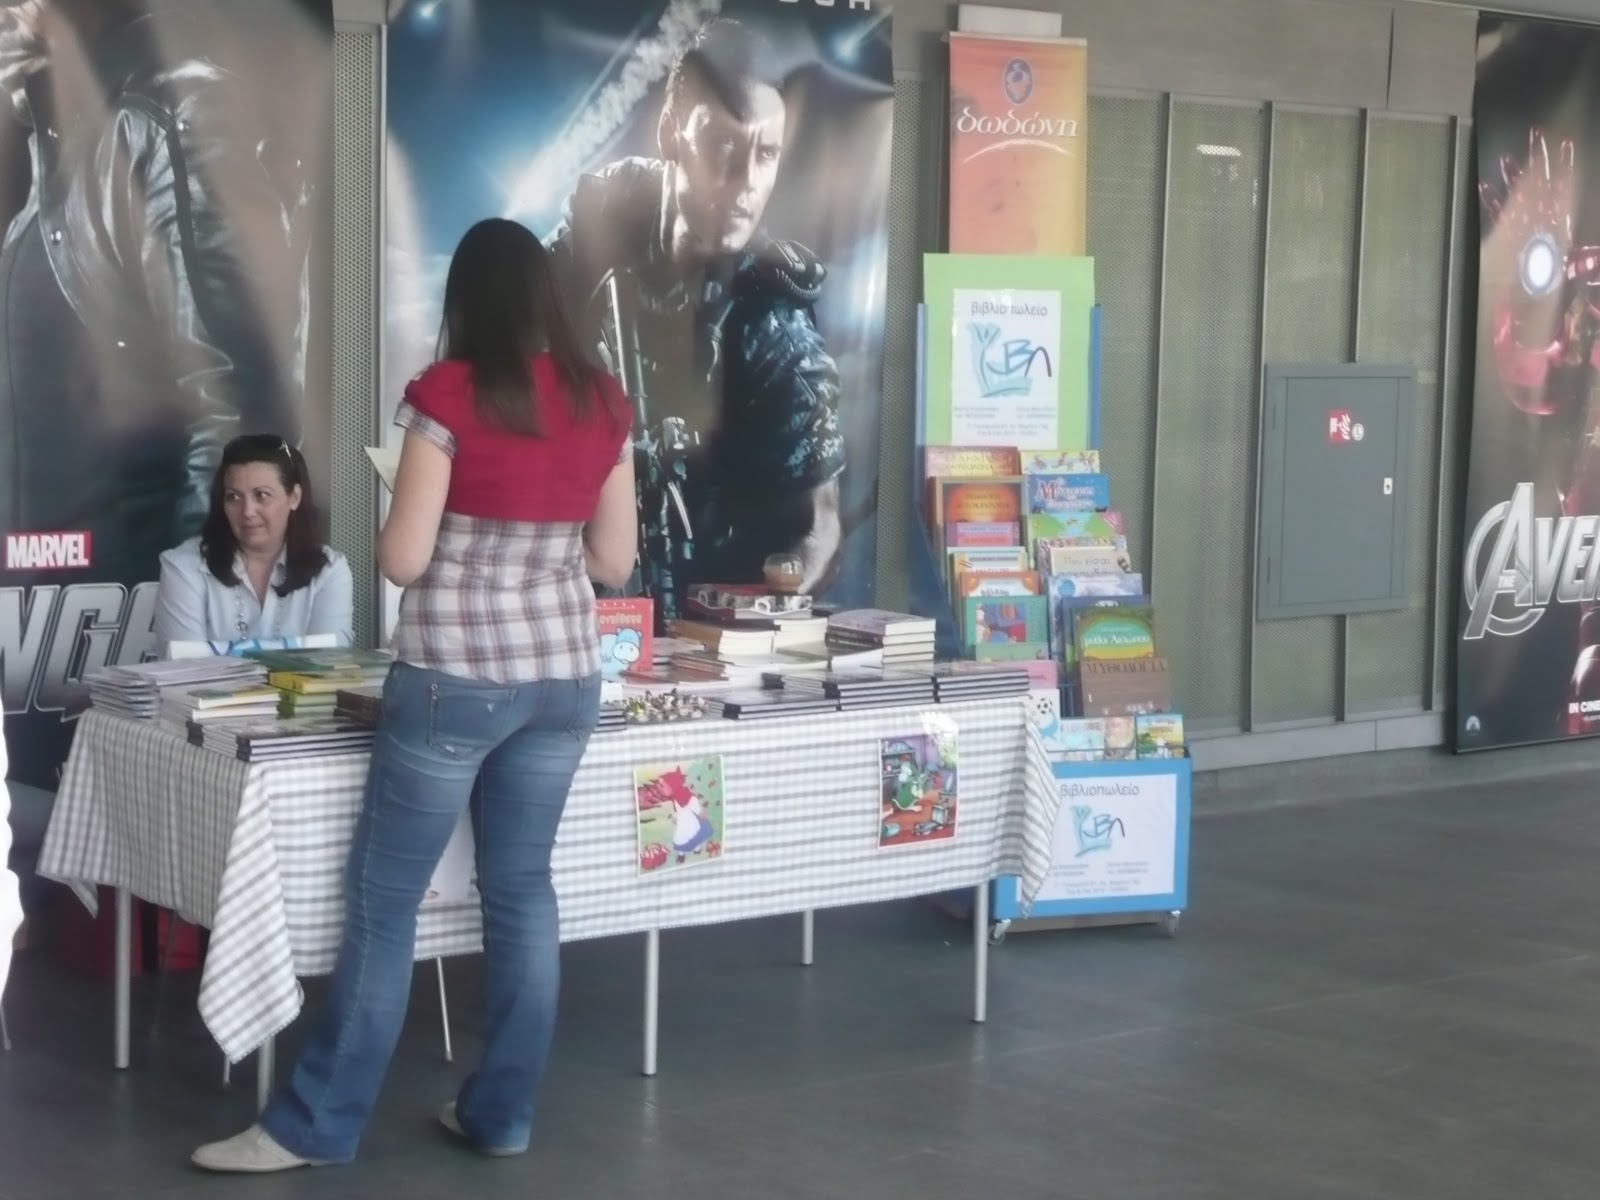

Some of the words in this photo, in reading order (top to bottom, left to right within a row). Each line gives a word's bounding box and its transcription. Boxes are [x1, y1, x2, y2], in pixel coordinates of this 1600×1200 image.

[957, 106, 1077, 137] δωδώνη
[7, 534, 89, 568] MARVEL
[1569, 702, 1579, 714] IN
[1060, 784, 1140, 799] βιβλιοπωλείο
